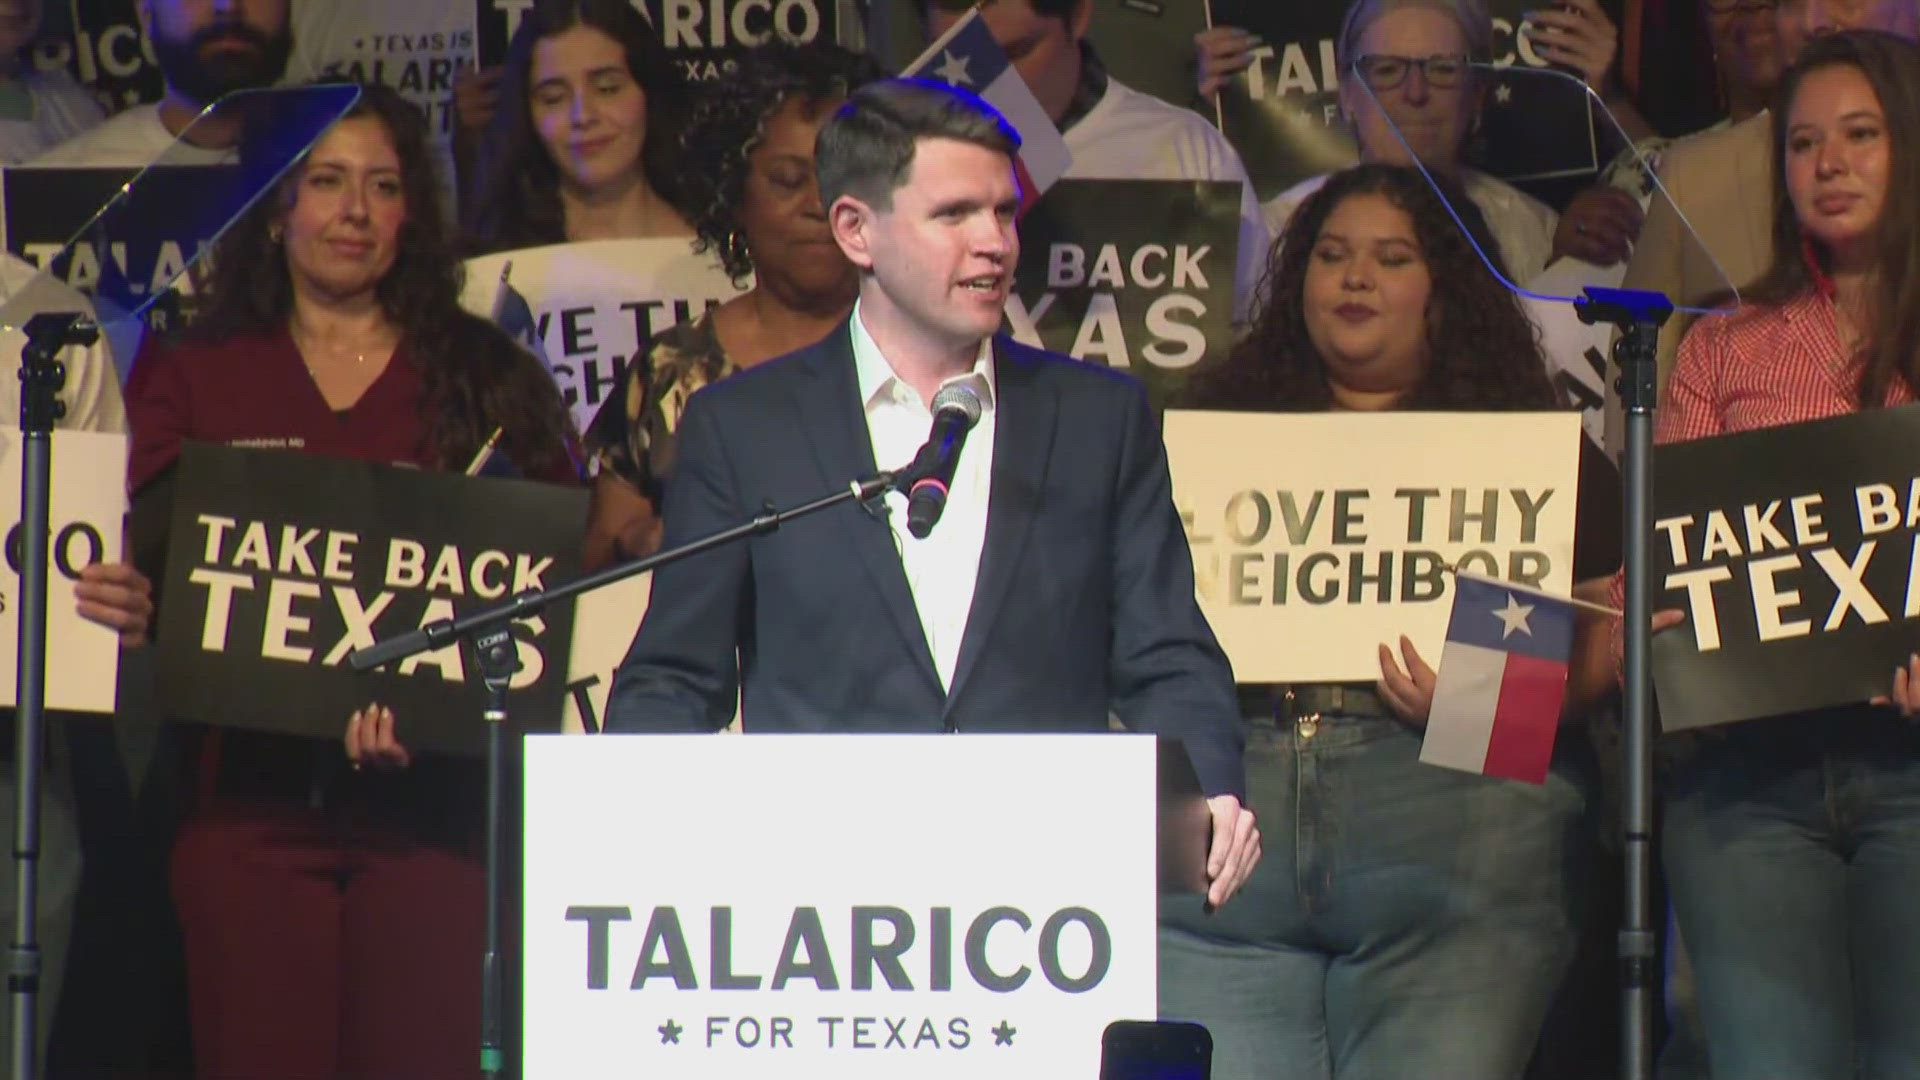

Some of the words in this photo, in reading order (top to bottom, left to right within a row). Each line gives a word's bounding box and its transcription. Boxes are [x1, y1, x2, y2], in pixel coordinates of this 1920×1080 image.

[373, 32, 444, 51] TEXAS
[451, 29, 472, 48] IS
[1048, 243, 1211, 289] BACK
[1004, 292, 1208, 368] XAS
[1394, 487, 1556, 545] THY
[1654, 493, 1830, 568] TAKE
[197, 514, 360, 581] TAKE
[384, 538, 554, 599] BACK
[189, 567, 547, 690] TEXAS
[564, 904, 1112, 994] TALARICO
[706, 1015, 794, 1049] FOR
[817, 1015, 971, 1050] TEXAS
